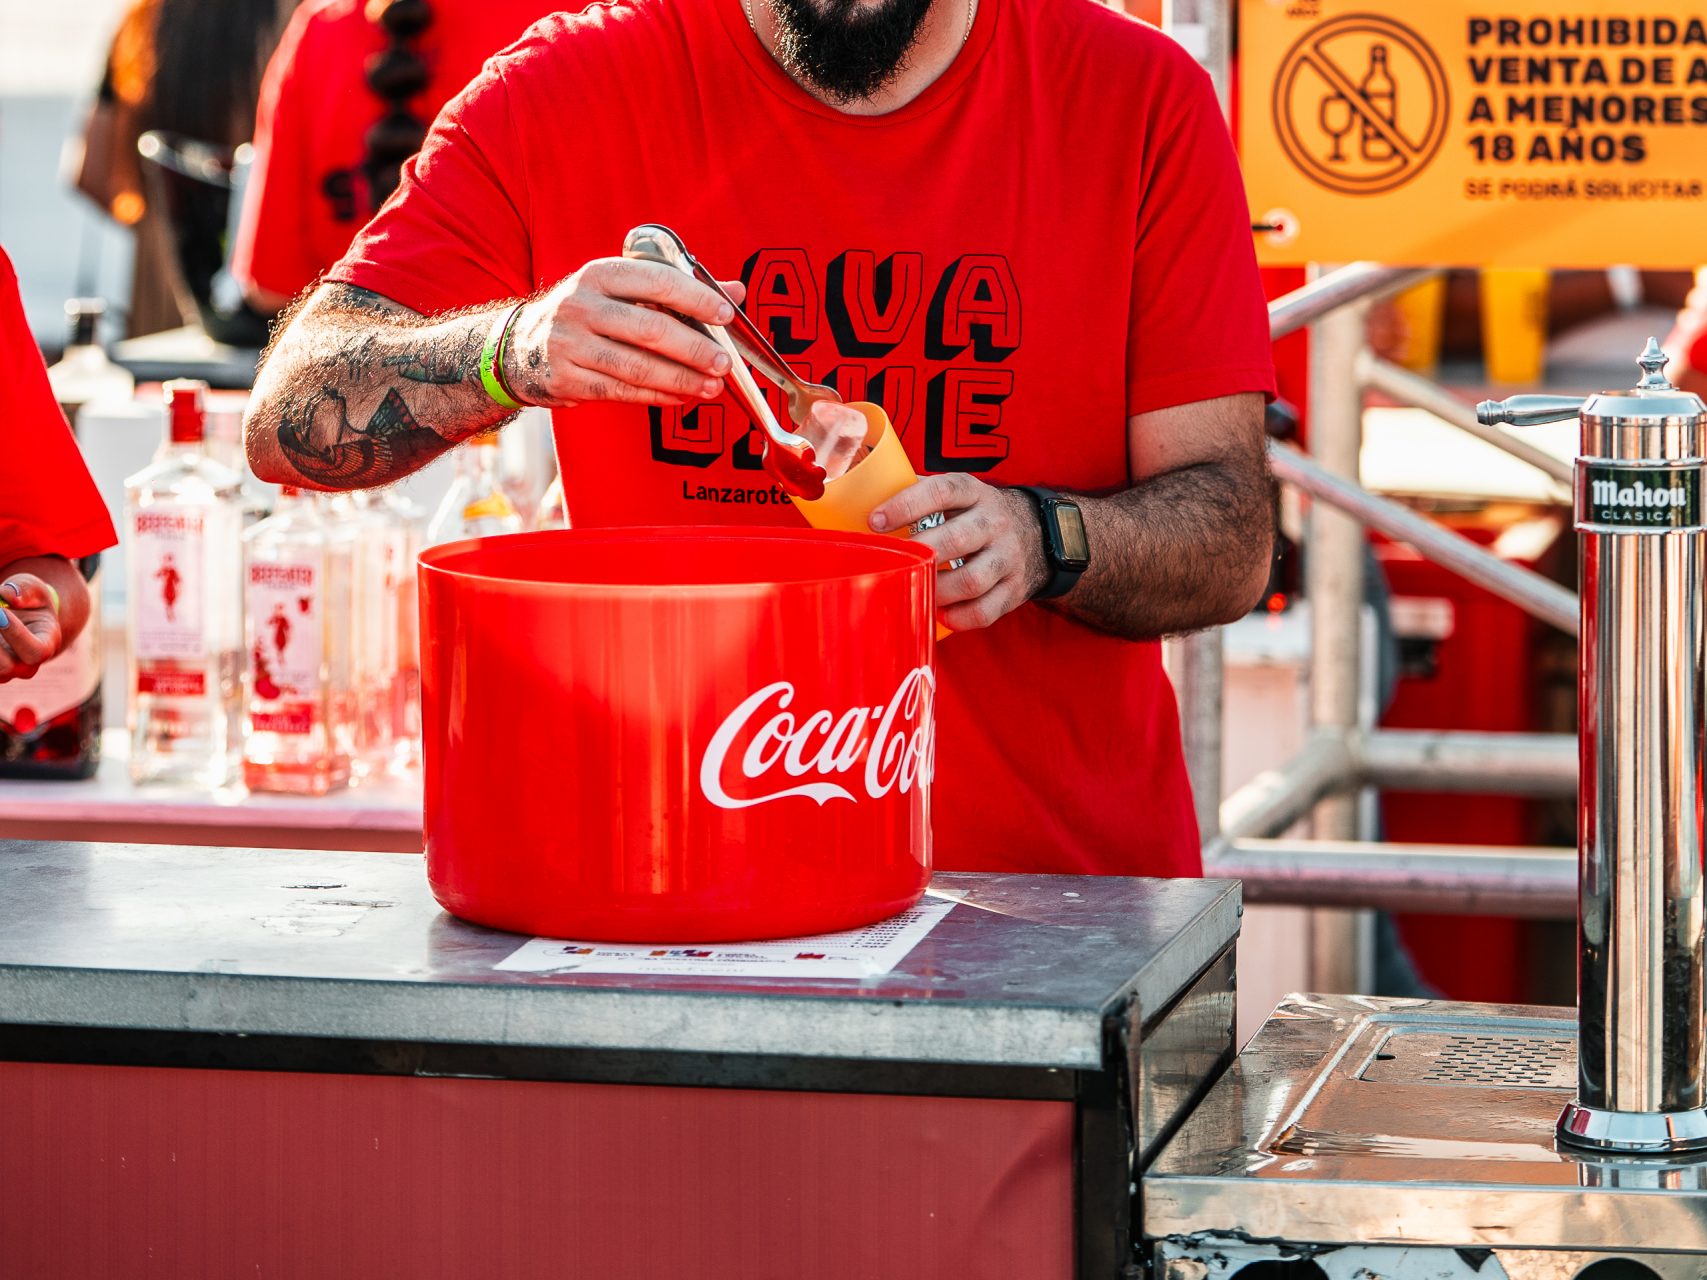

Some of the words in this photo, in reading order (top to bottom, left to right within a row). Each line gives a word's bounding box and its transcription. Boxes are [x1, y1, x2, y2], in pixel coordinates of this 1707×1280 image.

[1467, 17, 1707, 47] PROHIBIDA
[1467, 56, 1611, 85] VENTA
[1619, 56, 1676, 86] DE
[1466, 95, 1497, 124] A
[1506, 95, 1707, 128] MENORES
[1468, 133, 1517, 163] 18
[1526, 126, 1648, 163] AÑOS
[1465, 180, 1494, 197] SE
[738, 248, 1022, 362] AVA
[682, 480, 793, 505] Lanzarote
[1592, 479, 1687, 507] Mahou
